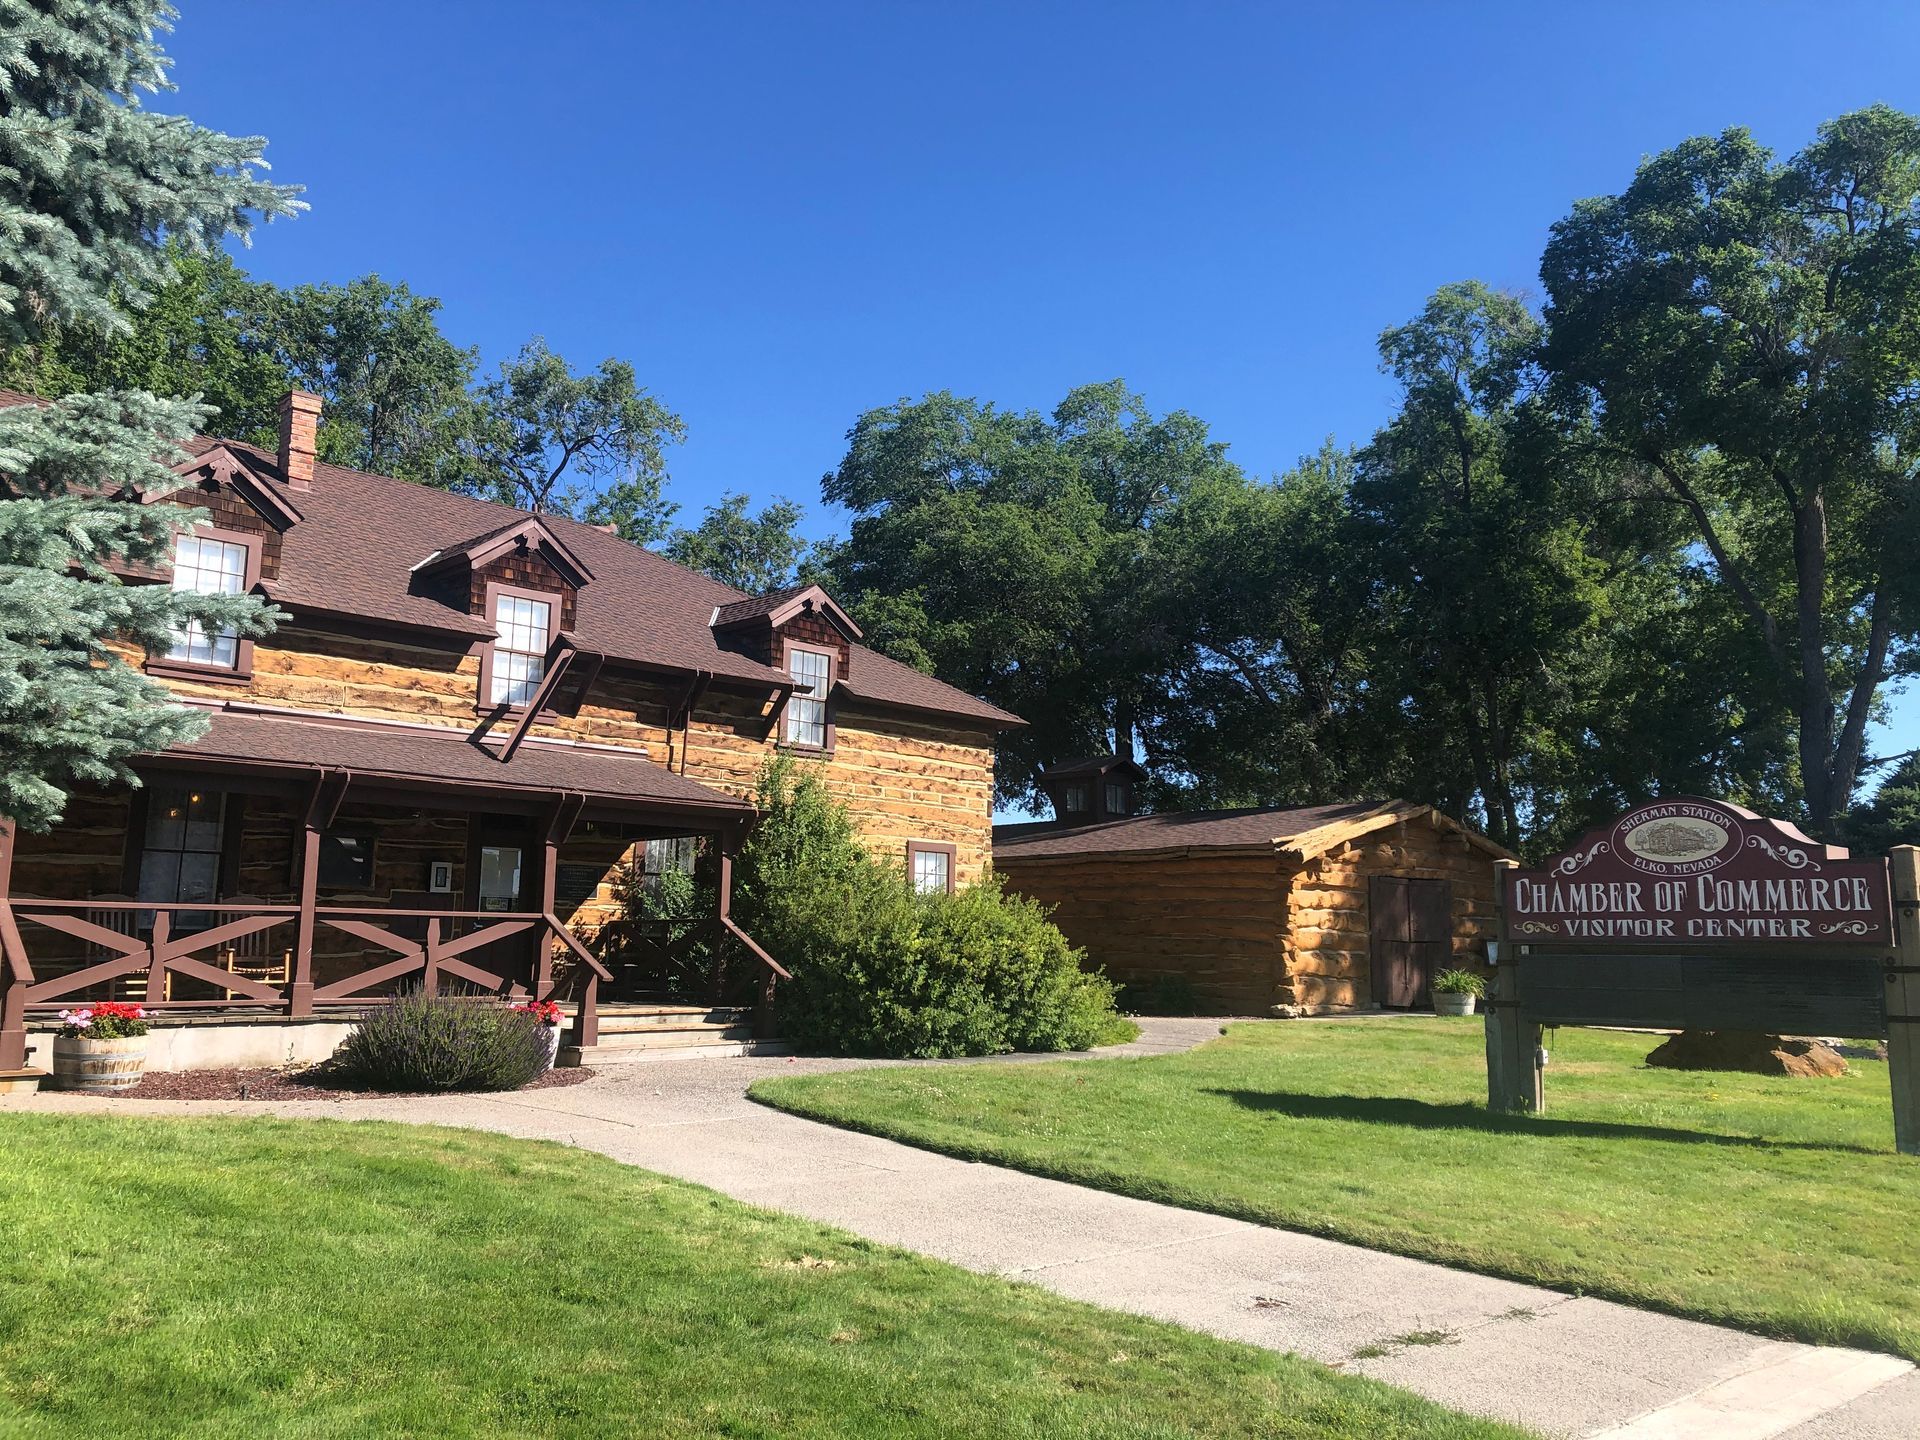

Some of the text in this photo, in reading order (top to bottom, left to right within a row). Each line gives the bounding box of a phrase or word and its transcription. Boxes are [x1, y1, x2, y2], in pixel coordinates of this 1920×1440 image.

[1620, 806, 1732, 833] SHERMAN STATION
[1673, 855, 1722, 873] NEVADA
[1515, 873, 1872, 916] CHAMBER OF COMMERCE
[1563, 918, 1815, 937] VISITOR CENTER
